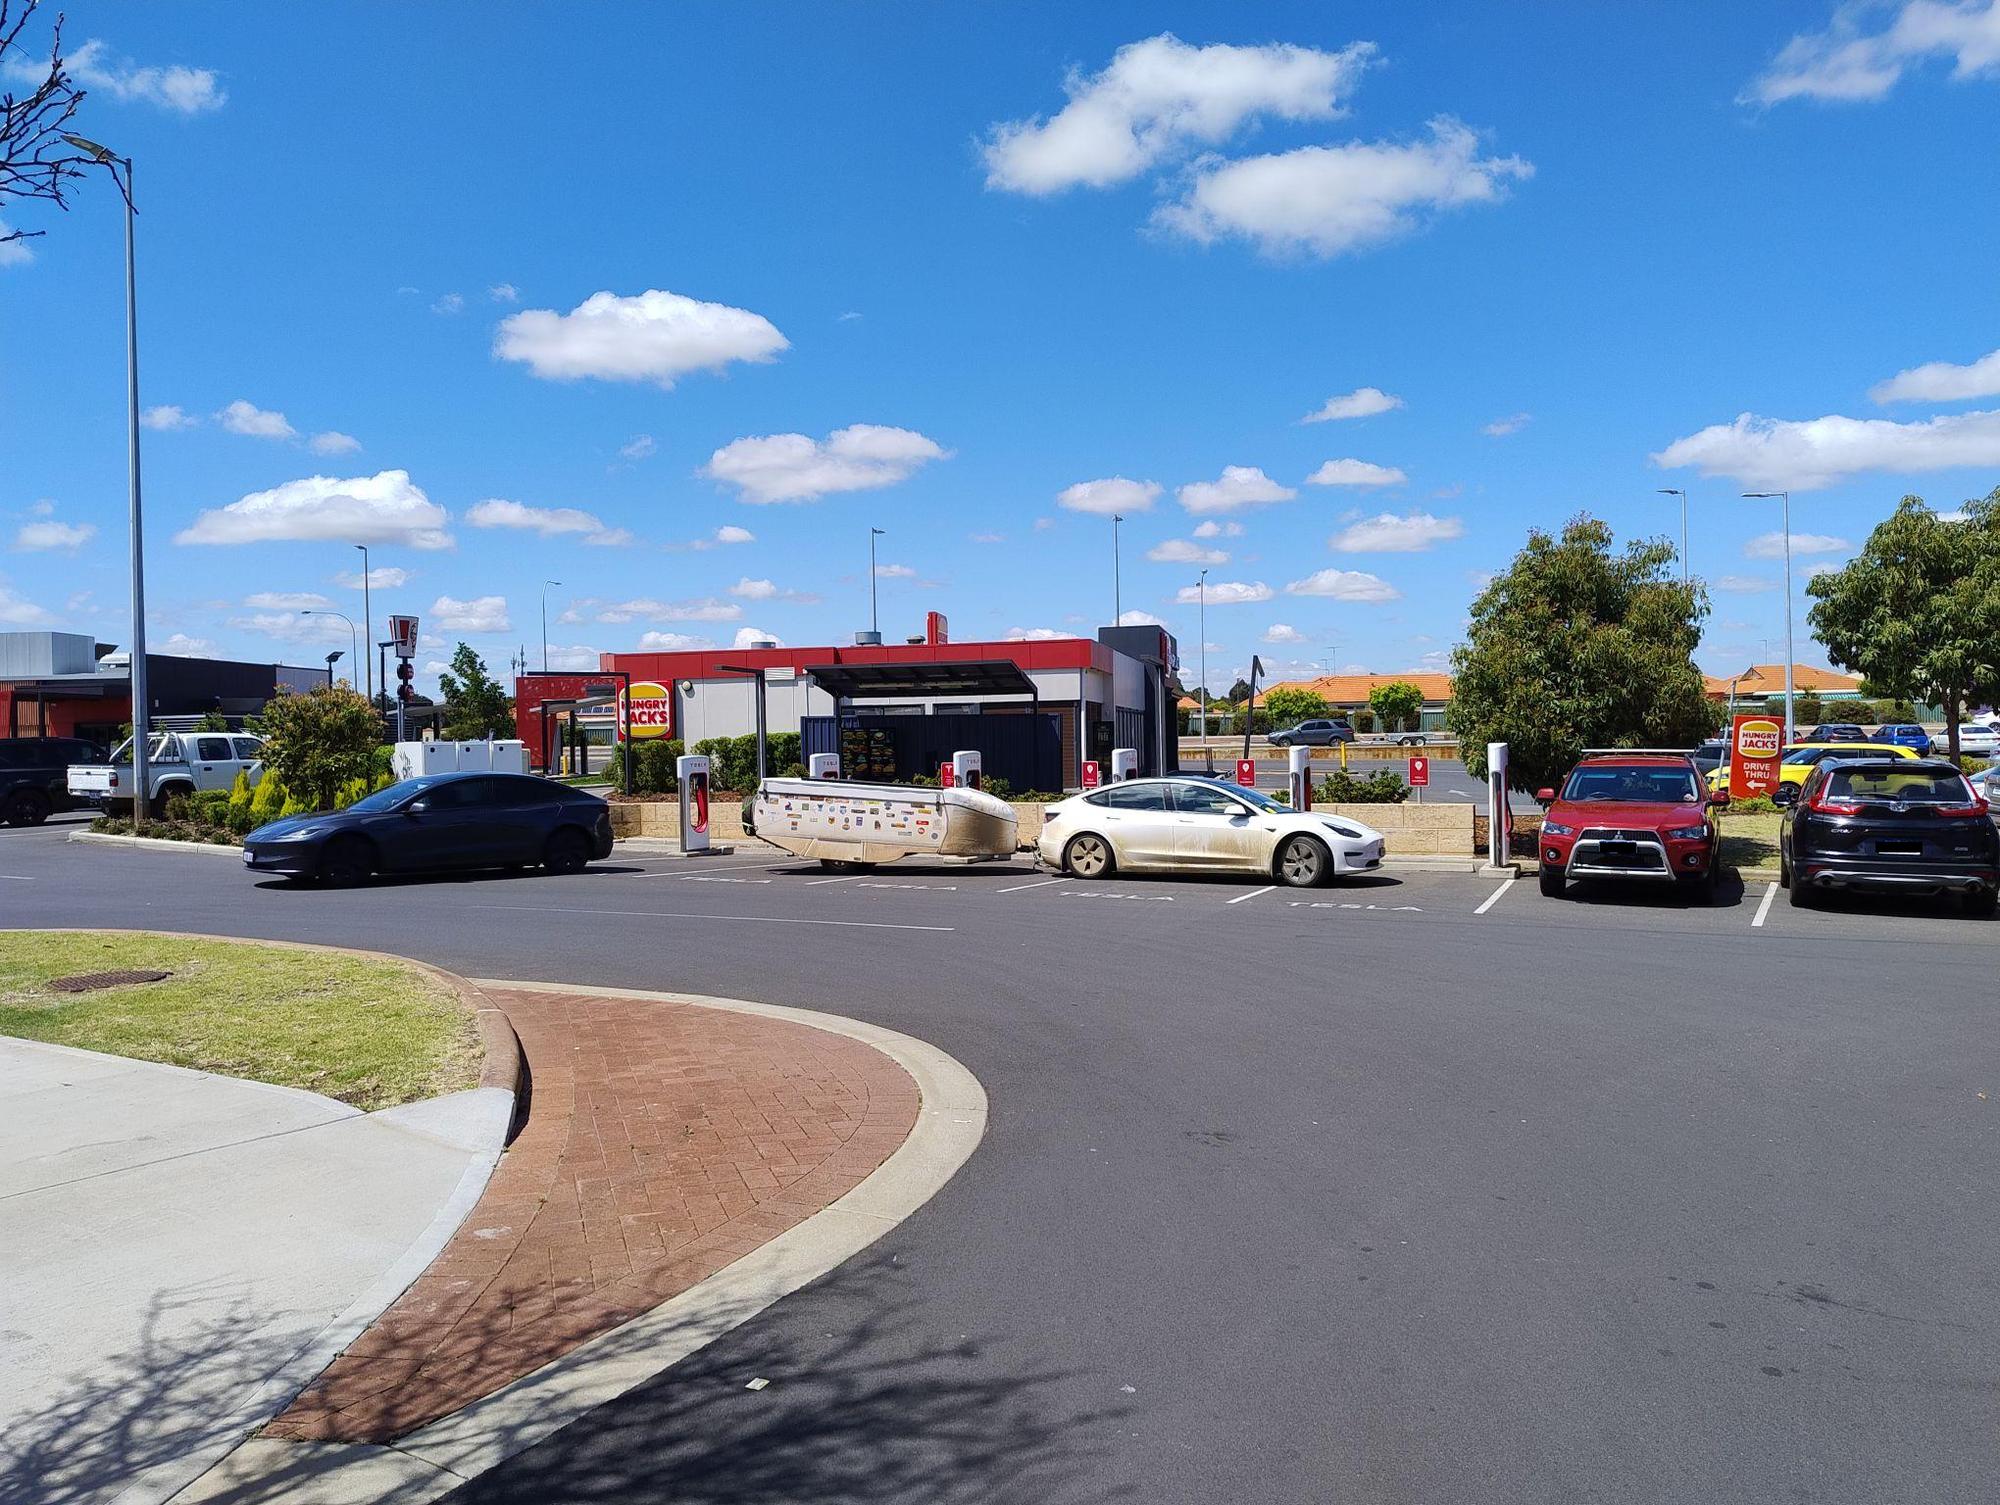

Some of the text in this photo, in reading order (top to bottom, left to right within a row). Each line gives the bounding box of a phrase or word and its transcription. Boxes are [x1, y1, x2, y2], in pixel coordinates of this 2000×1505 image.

[1743, 762, 1771, 771] DRIVE
[1744, 771, 1770, 779] THRU
[1286, 901, 1424, 912] TESLA
